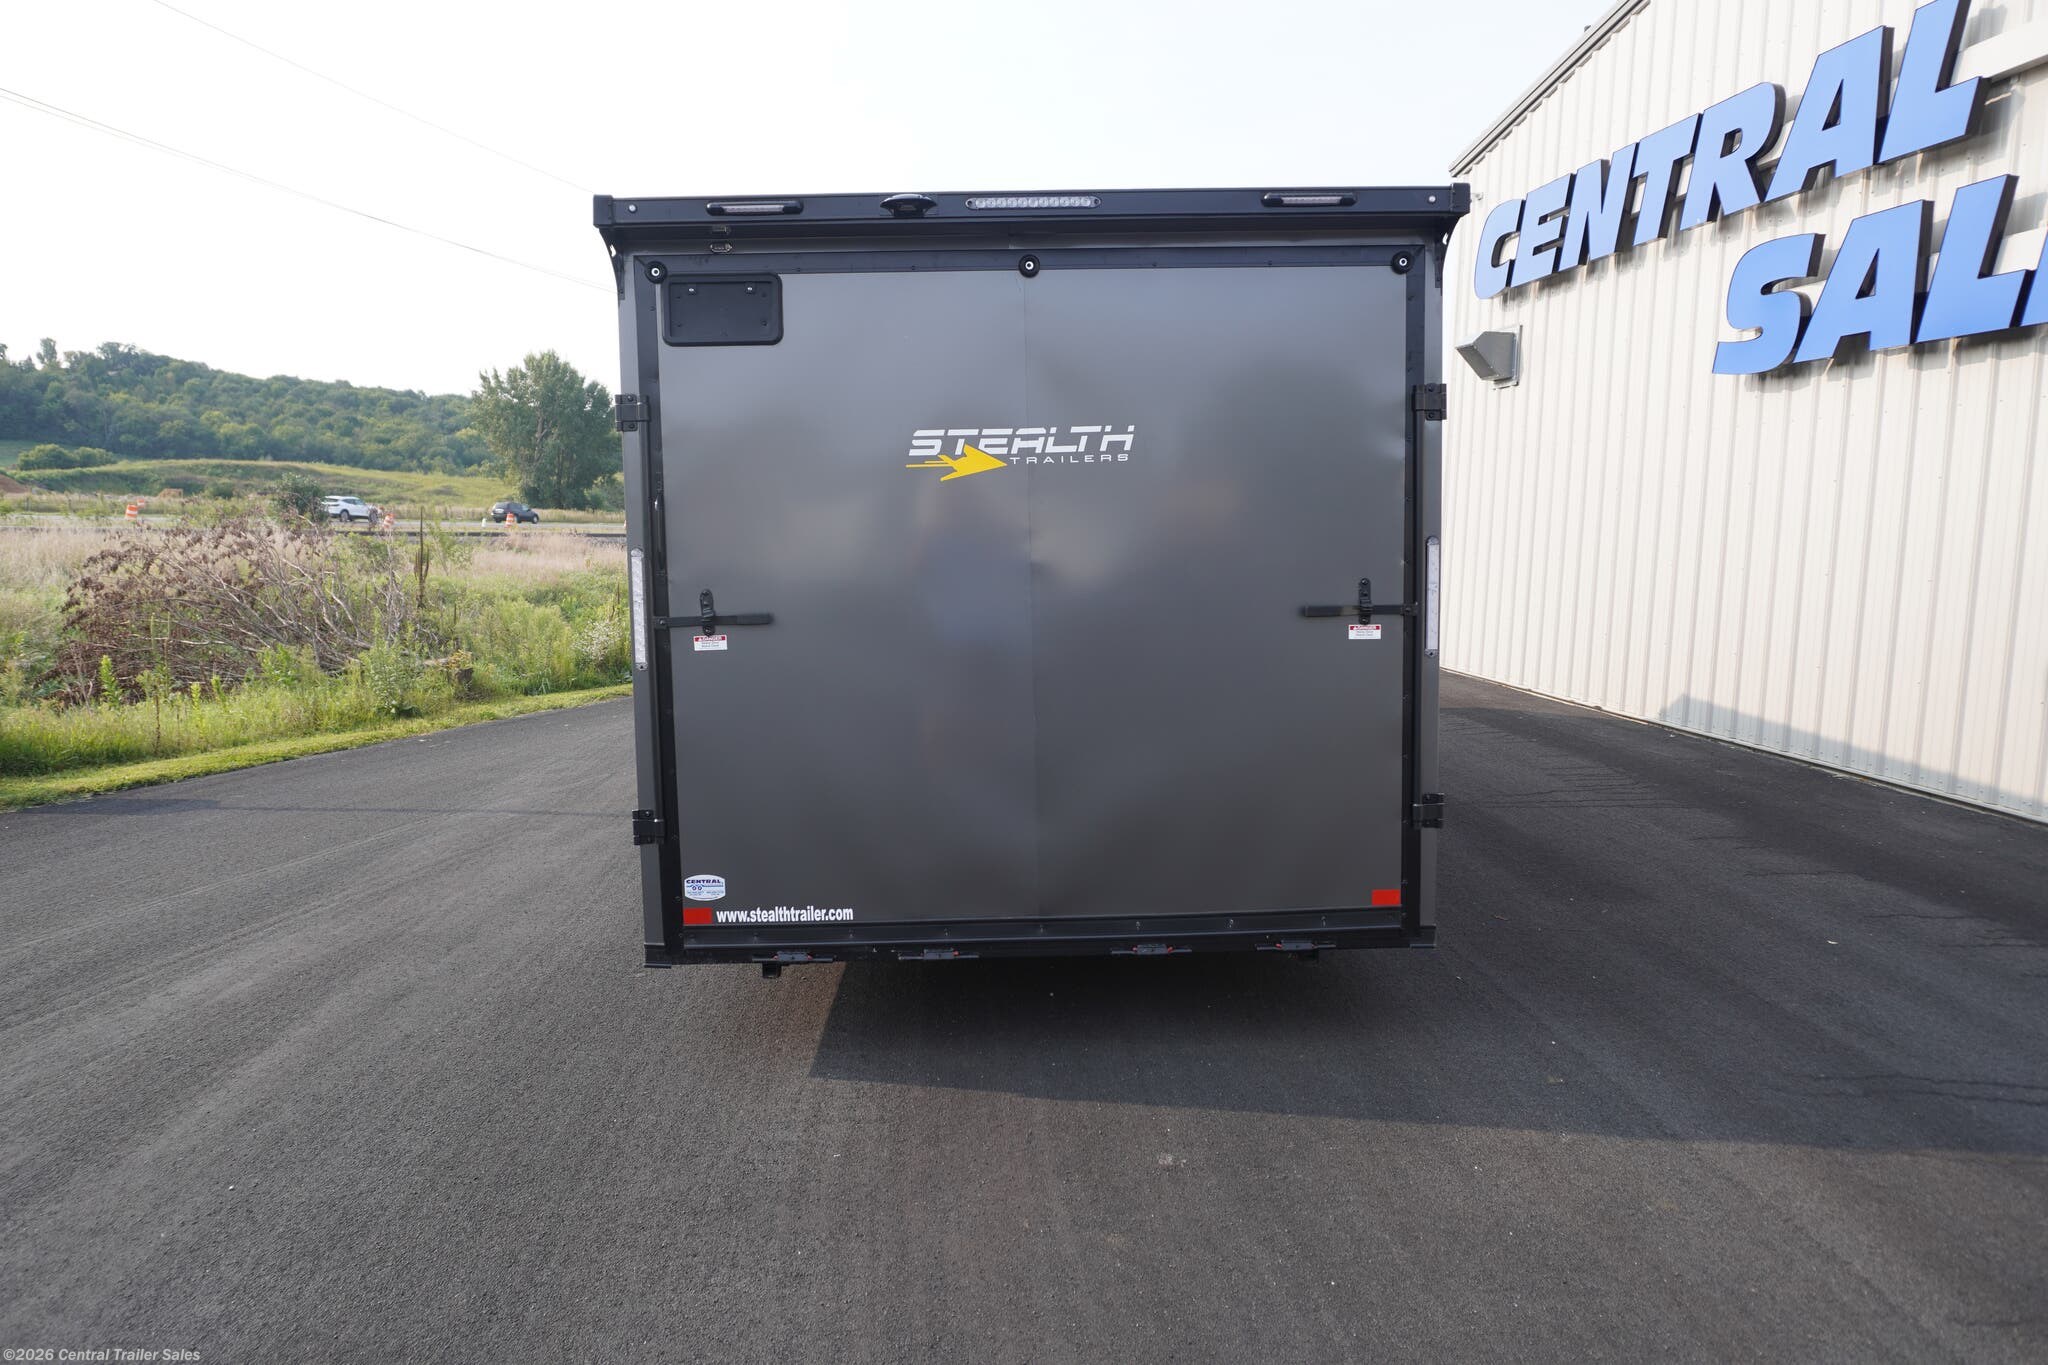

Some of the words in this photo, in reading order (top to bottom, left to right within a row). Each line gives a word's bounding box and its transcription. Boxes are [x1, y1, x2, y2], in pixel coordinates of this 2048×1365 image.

[1475, 0, 1983, 299] CENTRAL
[1712, 174, 2048, 375] SAL
[908, 425, 1135, 456] STEALTH
[1009, 454, 1129, 465] TRAILERS
[716, 906, 854, 923] www.stealthtrailer.com
